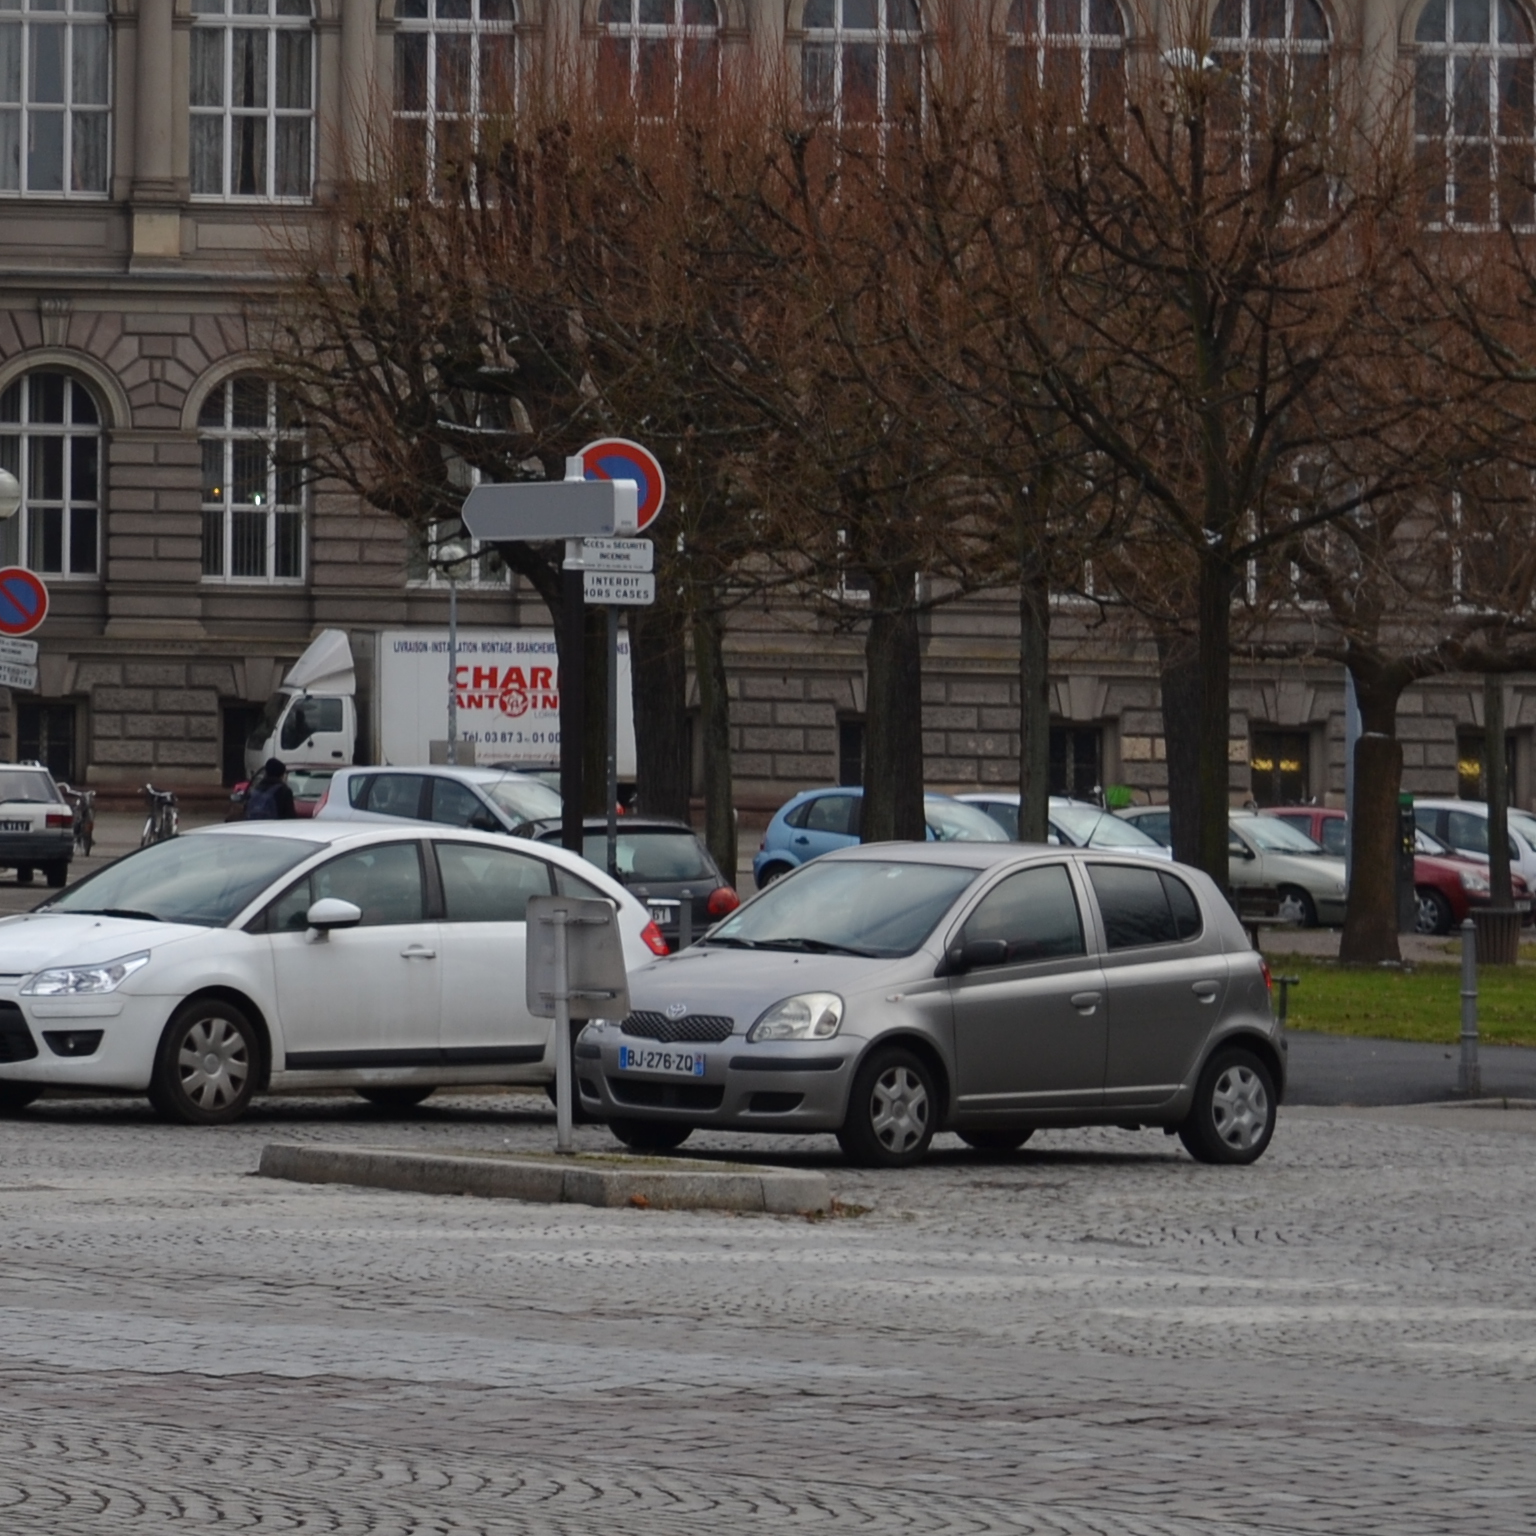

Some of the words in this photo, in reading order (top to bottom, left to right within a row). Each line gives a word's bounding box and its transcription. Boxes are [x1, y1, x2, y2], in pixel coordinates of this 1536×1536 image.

[591, 576, 640, 586] INTERDIT
[615, 589, 649, 599] CASES
[448, 666, 559, 690] CHAR
[484, 732, 498, 743] 03
[500, 732, 513, 743] 87
[532, 732, 545, 743] 01
